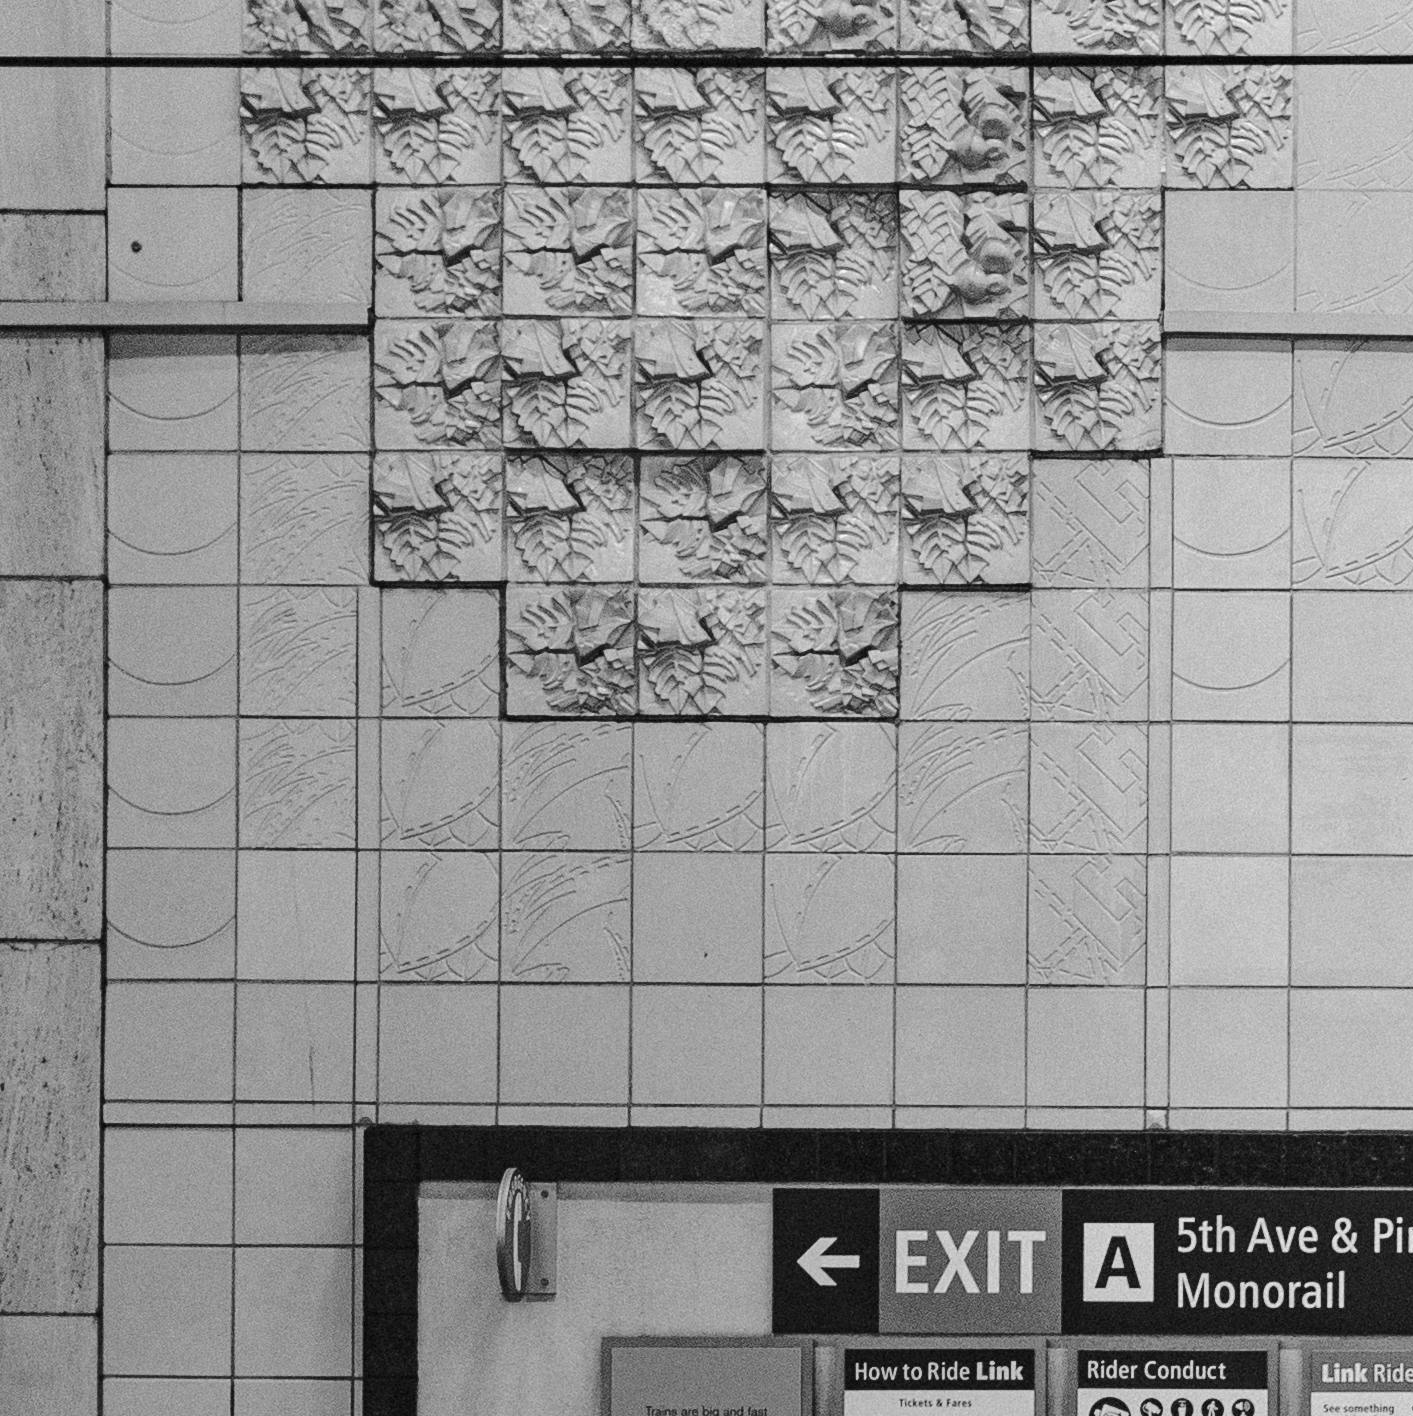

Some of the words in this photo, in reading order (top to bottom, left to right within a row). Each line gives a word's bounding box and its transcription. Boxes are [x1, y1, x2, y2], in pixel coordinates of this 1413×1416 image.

[1178, 1215, 1235, 1253] 5th
[1247, 1218, 1318, 1253] Ave
[1332, 1217, 1357, 1253] &
[896, 1231, 1046, 1293] EXIT
[1095, 1236, 1140, 1288] A
[1178, 1271, 1344, 1308] Monorail
[855, 1362, 897, 1380] How
[903, 1364, 922, 1380] to
[928, 1361, 970, 1380] Ride
[977, 1361, 1023, 1380] Link
[1088, 1360, 1138, 1379] Rider
[1144, 1360, 1226, 1379] Conduct
[1322, 1363, 1367, 1382] Link
[646, 1405, 677, 1416] Trains
[681, 1408, 699, 1416] are
[723, 1406, 744, 1416] and
[748, 1406, 768, 1416] fast
[899, 1398, 933, 1407] Tickets
[936, 1398, 943, 1407] &
[946, 1398, 972, 1407] Fares
[1323, 1404, 1340, 1412] See
[1343, 1404, 1395, 1415] something
